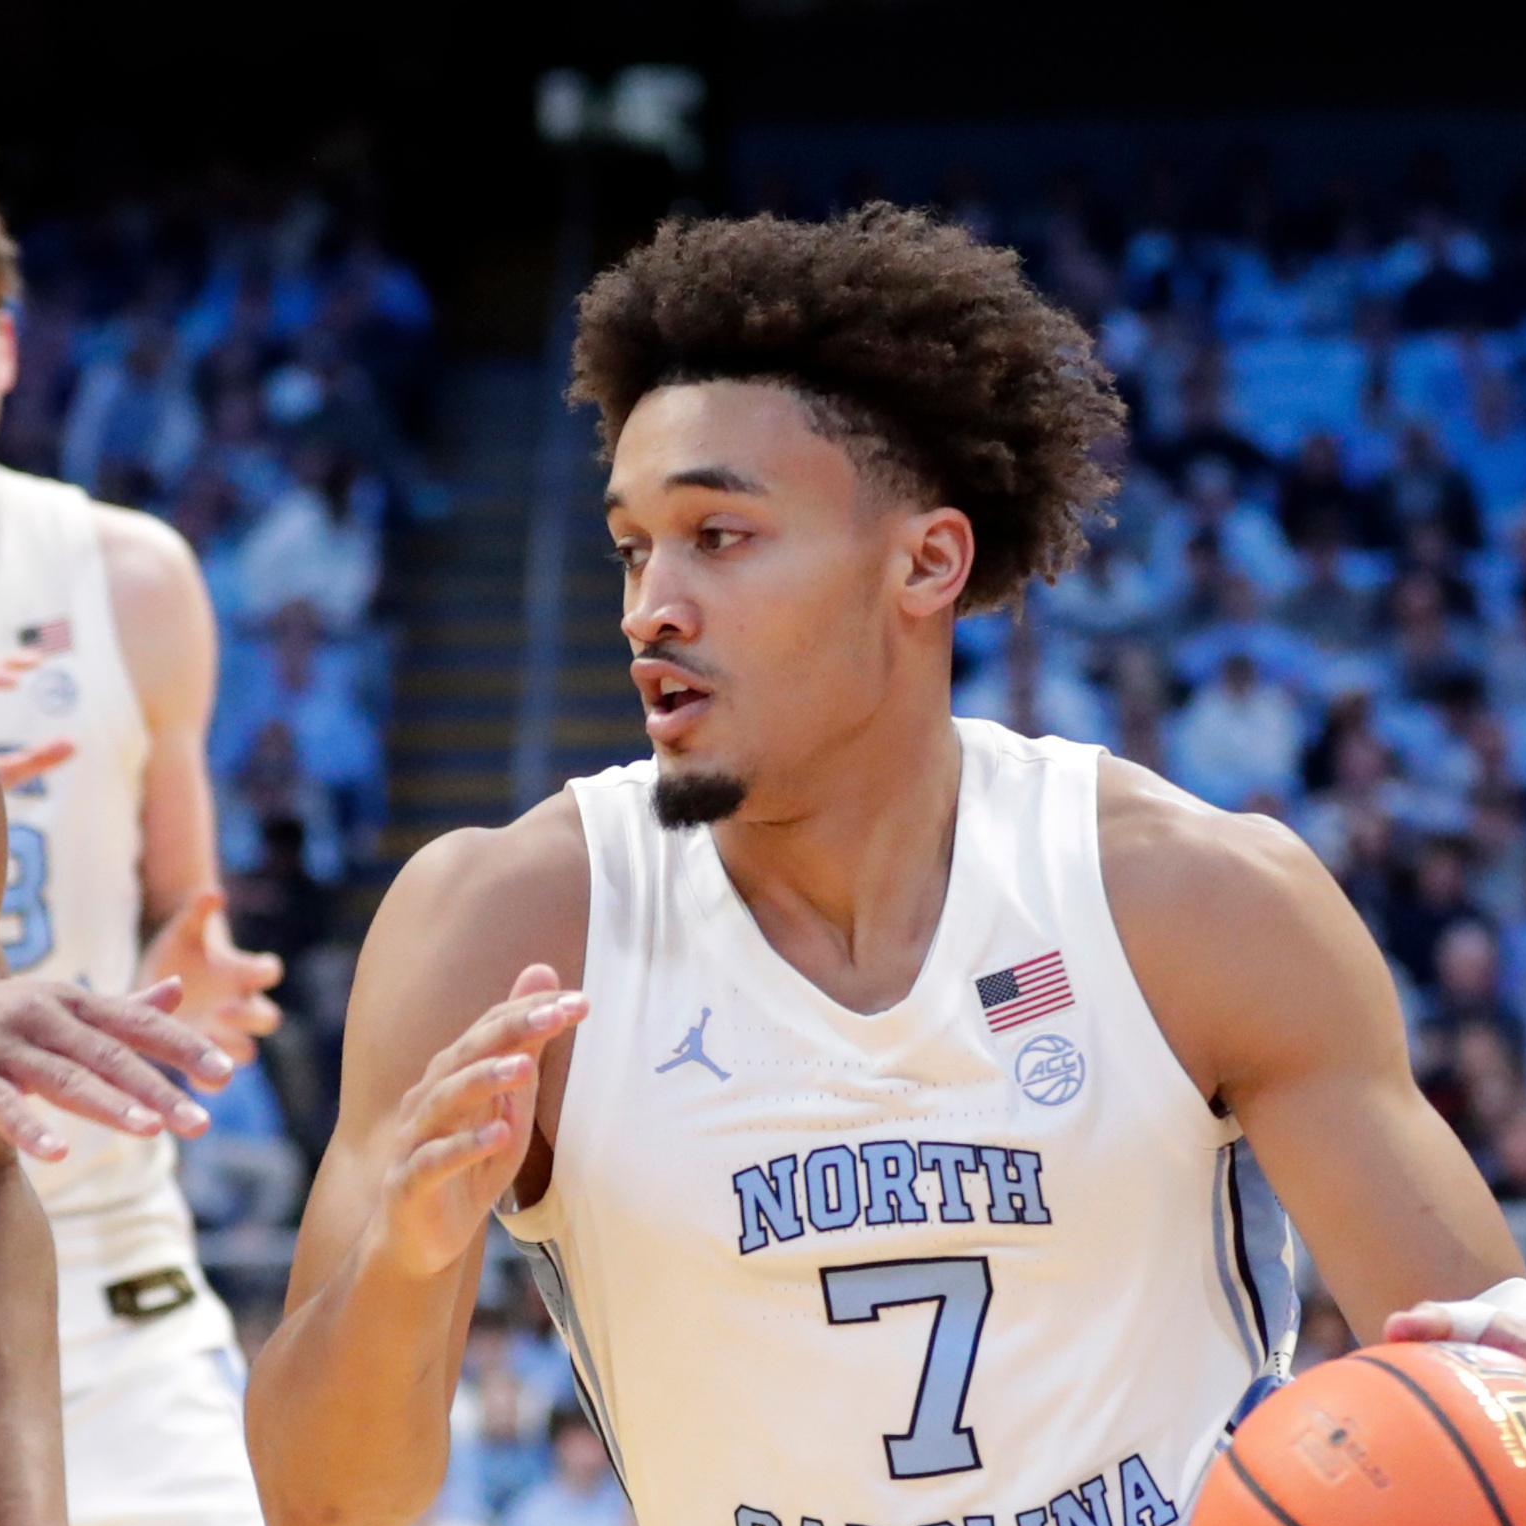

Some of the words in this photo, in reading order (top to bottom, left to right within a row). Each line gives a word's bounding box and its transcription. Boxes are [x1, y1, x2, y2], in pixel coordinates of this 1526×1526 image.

[1026, 1050, 1077, 1080] ACC
[732, 1141, 1053, 1255] NORTH
[820, 1256, 993, 1480] 7
